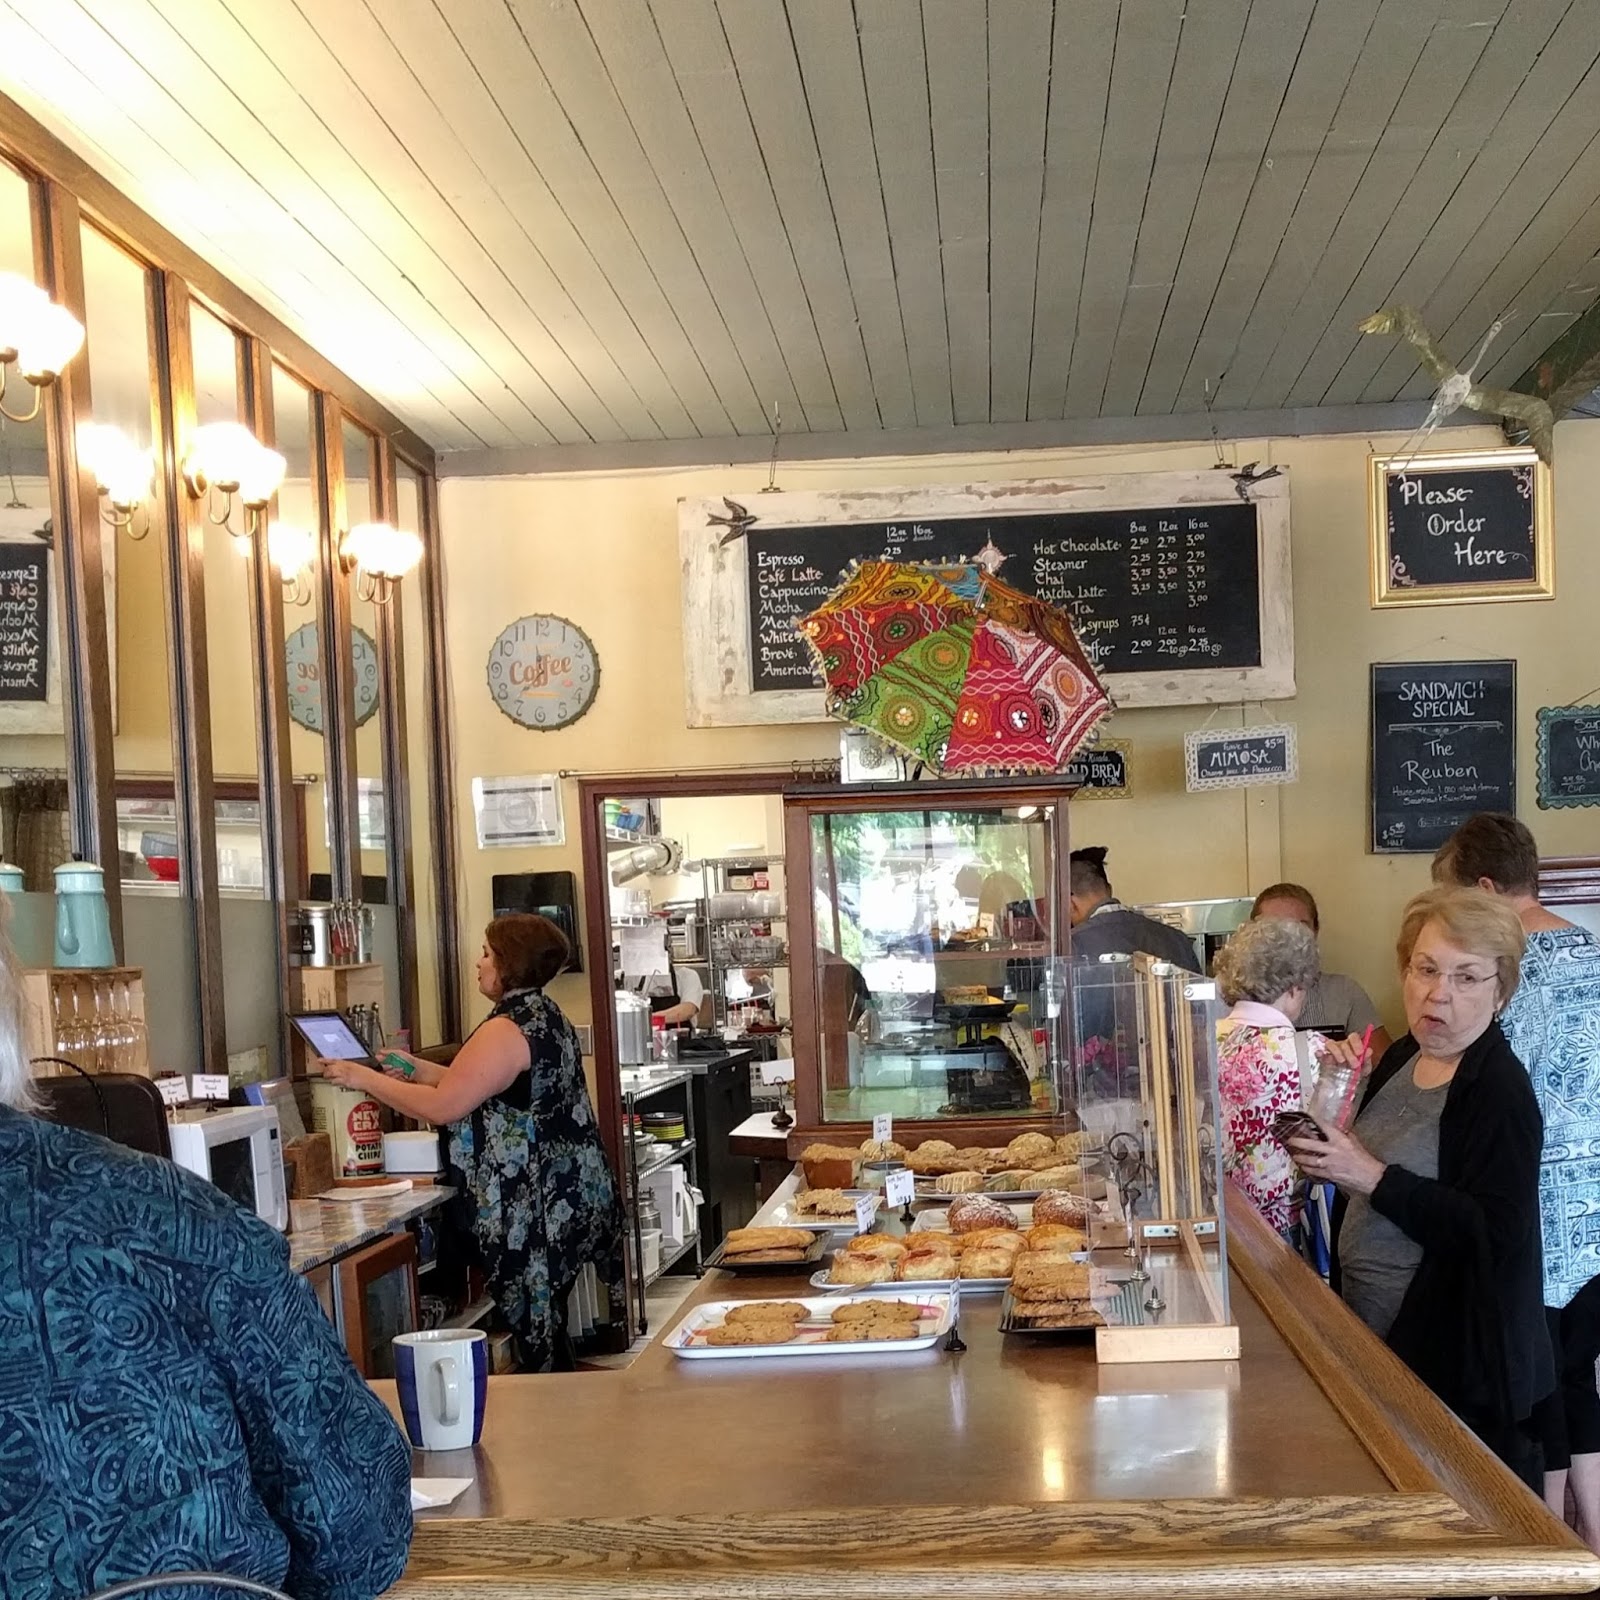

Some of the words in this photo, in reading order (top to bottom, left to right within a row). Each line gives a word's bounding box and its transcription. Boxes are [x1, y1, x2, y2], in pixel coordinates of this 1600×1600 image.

[1398, 474, 1474, 505] Please
[1427, 508, 1486, 536] Order
[1033, 538, 1057, 555] Hot
[1060, 537, 1120, 553] Chocolate
[1454, 536, 1518, 566] Here
[757, 551, 805, 571] Espresso
[1033, 557, 1088, 572] Steamer
[758, 568, 786, 587] Café
[792, 567, 822, 582] Latte
[1034, 572, 1065, 586] Chai
[759, 583, 830, 602] Cappuccino
[1035, 586, 1075, 601] Matcha
[1078, 585, 1106, 599] Latte
[759, 600, 803, 615] Mocha
[1071, 601, 1094, 614] Tea
[514, 625, 526, 642] 11
[535, 619, 550, 637] 12
[561, 624, 567, 643] 1
[1086, 619, 1120, 636] syrups
[760, 630, 795, 644] White
[499, 640, 515, 657] 10
[573, 640, 585, 659] 2
[760, 647, 795, 661] Brevé
[490, 661, 503, 679] 9
[509, 654, 573, 687] Coffee
[579, 664, 591, 682] 3
[497, 683, 509, 701] 8
[1398, 680, 1486, 701] SANDWICH
[534, 706, 546, 723] 6
[557, 702, 568, 719] 5
[1412, 701, 1475, 718] SPECIAL
[1424, 738, 1455, 757] The
[1210, 749, 1272, 767] MIMOSA
[1092, 763, 1122, 778] BREW
[1401, 760, 1479, 785] Reuben
[352, 1110, 380, 1121] NEW
